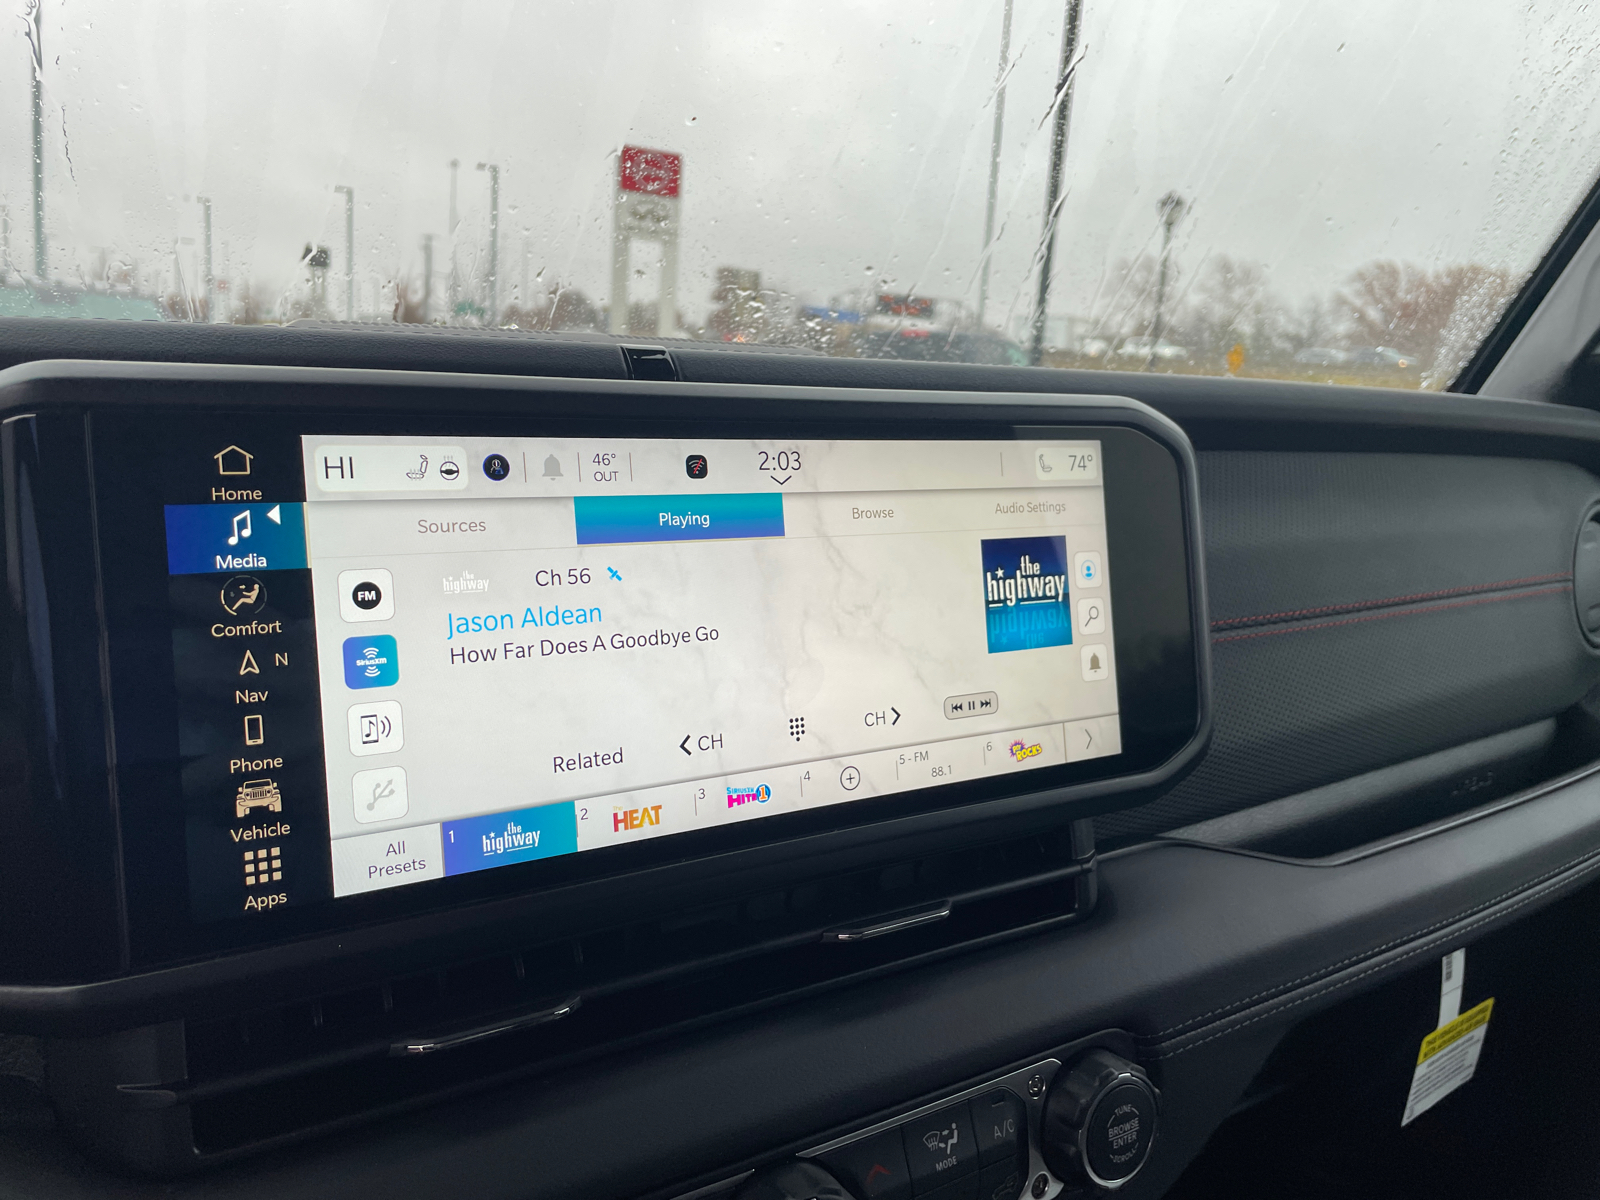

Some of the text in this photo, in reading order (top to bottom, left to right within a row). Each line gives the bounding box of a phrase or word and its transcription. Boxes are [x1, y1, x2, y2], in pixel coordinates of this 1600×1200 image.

[323, 456, 355, 480] HI
[592, 453, 617, 466] 46°
[759, 450, 802, 471] 2:03
[1068, 453, 1093, 472] 74°
[593, 470, 619, 482] OUT
[211, 487, 262, 501] Home
[851, 506, 895, 520] Browse
[994, 500, 1067, 515] Audio Settings
[417, 518, 487, 534] Sources
[658, 512, 710, 528] Playing
[215, 554, 267, 569] Media
[1020, 554, 1040, 575] the
[442, 576, 490, 594] highway
[535, 568, 592, 587] Ch 56
[986, 566, 1065, 606] highway
[357, 590, 377, 601] FM
[211, 620, 282, 637] Comfort
[447, 604, 602, 640] Jason Aldean
[450, 625, 720, 665] How Far Does A Goodbye Go
[275, 652, 289, 666] N
[235, 689, 269, 704] Nav
[863, 711, 887, 728] CH
[697, 733, 724, 751] CH
[986, 741, 993, 752] 6
[553, 747, 624, 773] Related
[899, 754, 906, 765] 5
[914, 750, 929, 764] FM
[1015, 743, 1042, 762] ROCKS
[229, 756, 283, 774] Phone
[930, 764, 953, 778] 88.1
[803, 771, 811, 782] 4
[698, 788, 706, 800] 3
[760, 786, 769, 801] 1
[580, 808, 589, 821] 2
[612, 804, 663, 833] HEAT
[230, 822, 291, 843] Vehicle
[448, 830, 455, 844] 1
[507, 822, 522, 835] the
[385, 841, 406, 857] All
[482, 829, 541, 855] highway
[368, 858, 426, 879] Presets
[244, 891, 287, 911] Apps
[1114, 1104, 1132, 1116] TUNE
[994, 1118, 1015, 1139] A/C
[1108, 1117, 1139, 1137] BROWSE
[1113, 1131, 1137, 1149] ENTER
[935, 1155, 958, 1172] MODE
